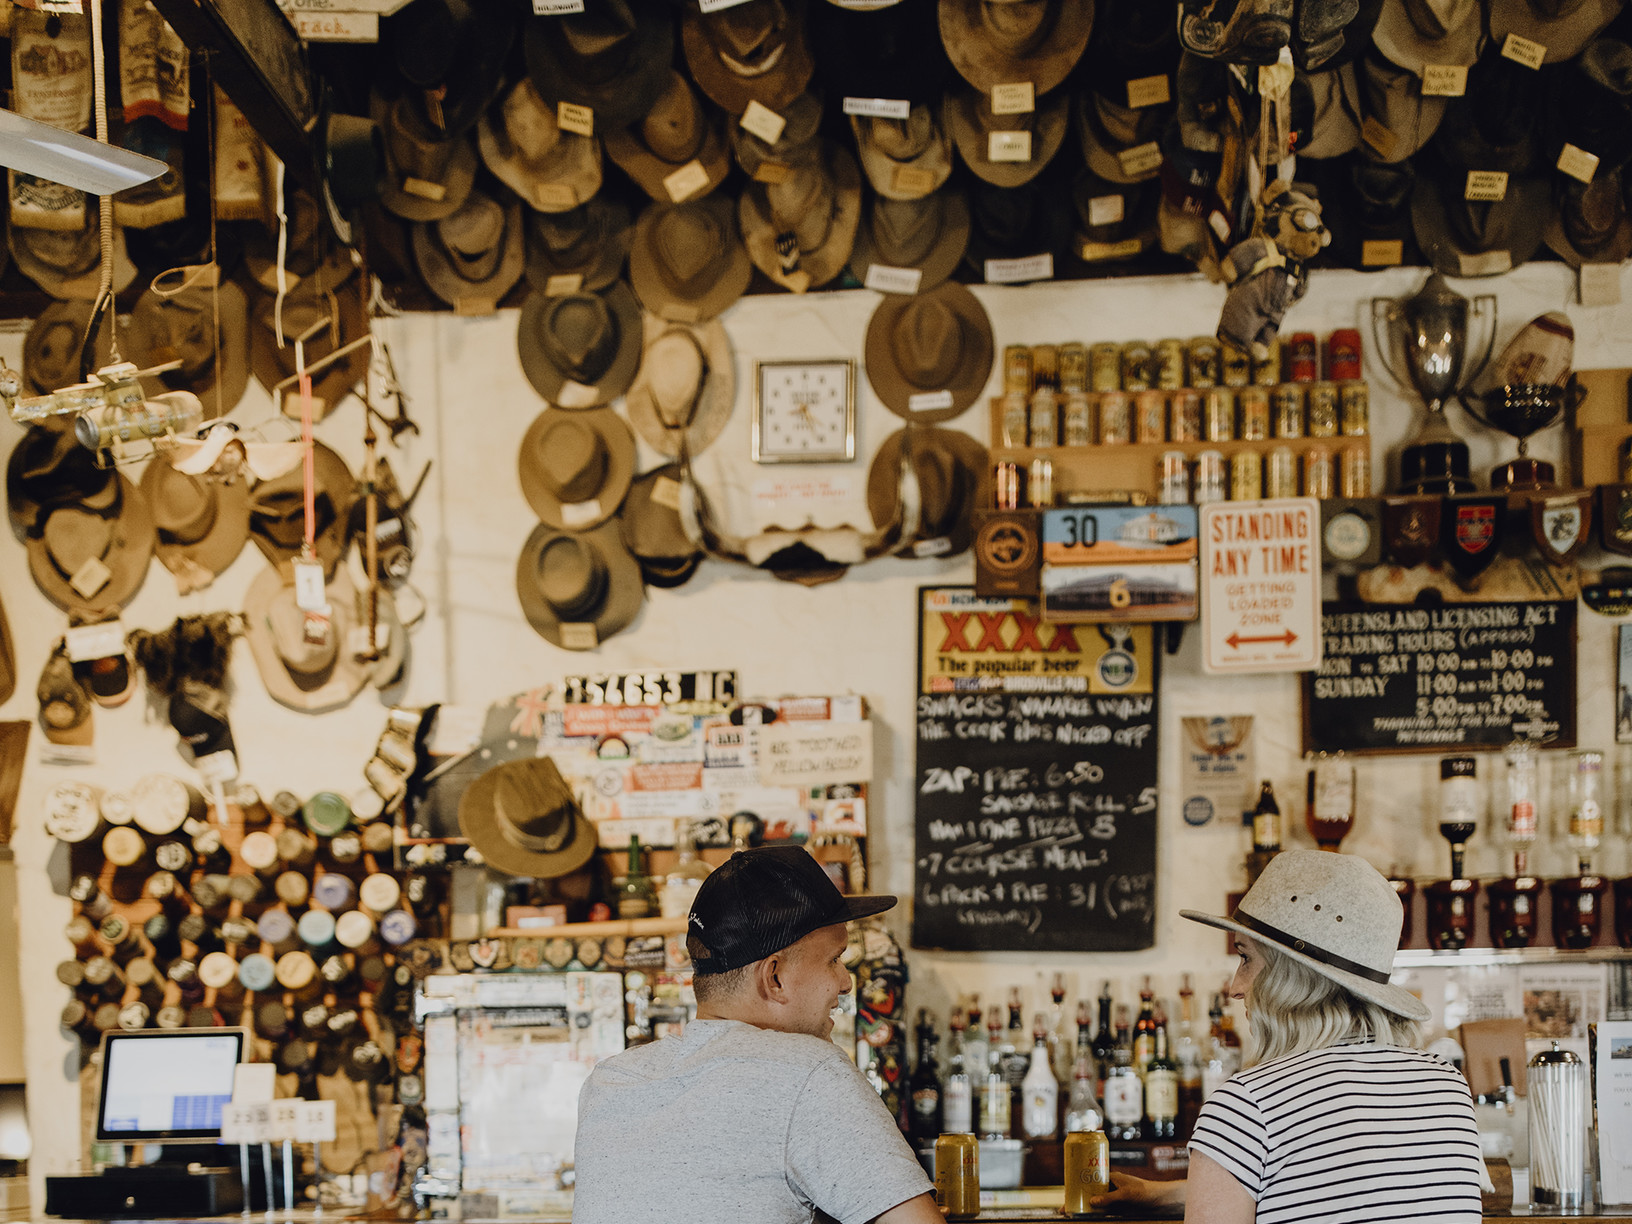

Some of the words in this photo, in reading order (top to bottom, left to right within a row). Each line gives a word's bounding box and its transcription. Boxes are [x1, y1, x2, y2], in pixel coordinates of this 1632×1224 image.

[1063, 514, 1098, 548] 30
[1212, 511, 1308, 543] STANDING
[1213, 549, 1251, 577] ANY
[1262, 545, 1308, 574] TIME
[1109, 580, 1131, 608] 6
[1229, 598, 1294, 610] LOADED
[1240, 613, 1281, 626] ZONE
[1432, 606, 1519, 628] LICENSING
[1523, 604, 1558, 625] ACT
[939, 612, 1082, 652] XXXX
[1397, 631, 1456, 652] HOURS
[938, 656, 966, 671] The
[974, 657, 1036, 674] popular
[1043, 655, 1080, 671] beer
[1378, 654, 1410, 674] SAT
[1314, 675, 1390, 699] SUNDAY
[1113, 723, 1152, 747] OFF
